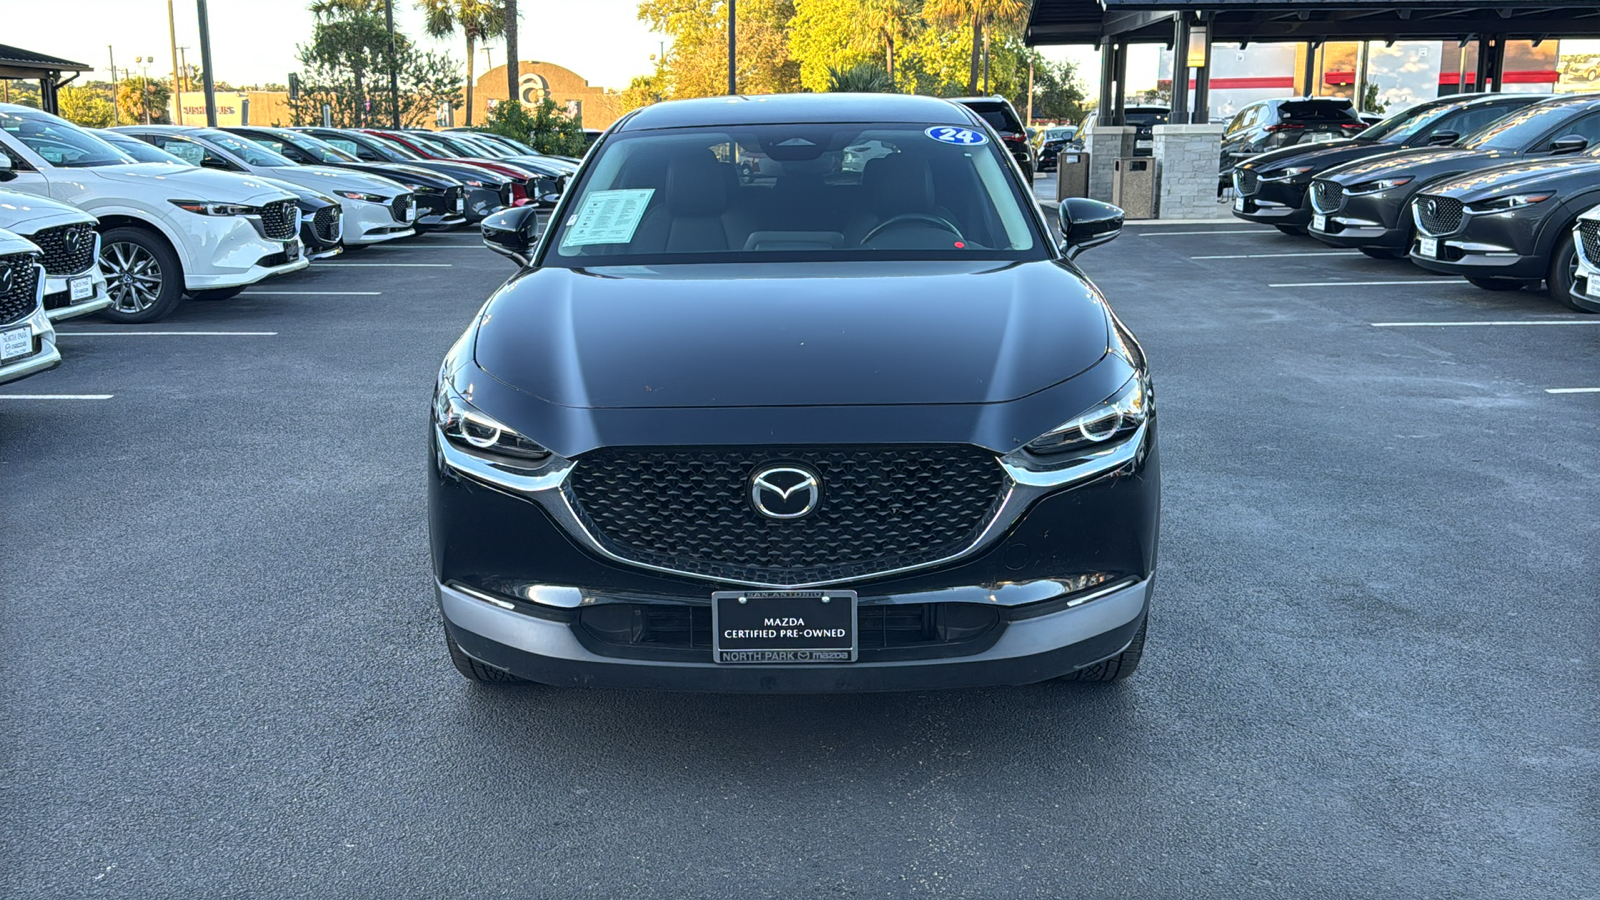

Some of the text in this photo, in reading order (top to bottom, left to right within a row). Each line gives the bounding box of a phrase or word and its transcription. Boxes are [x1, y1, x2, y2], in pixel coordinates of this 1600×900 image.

[938, 128, 974, 143] 24
[764, 618, 805, 627] MAZDA
[724, 628, 846, 639] CERTIFIED PRE-OWNED
[722, 651, 849, 662] NORTH PARK mazda
